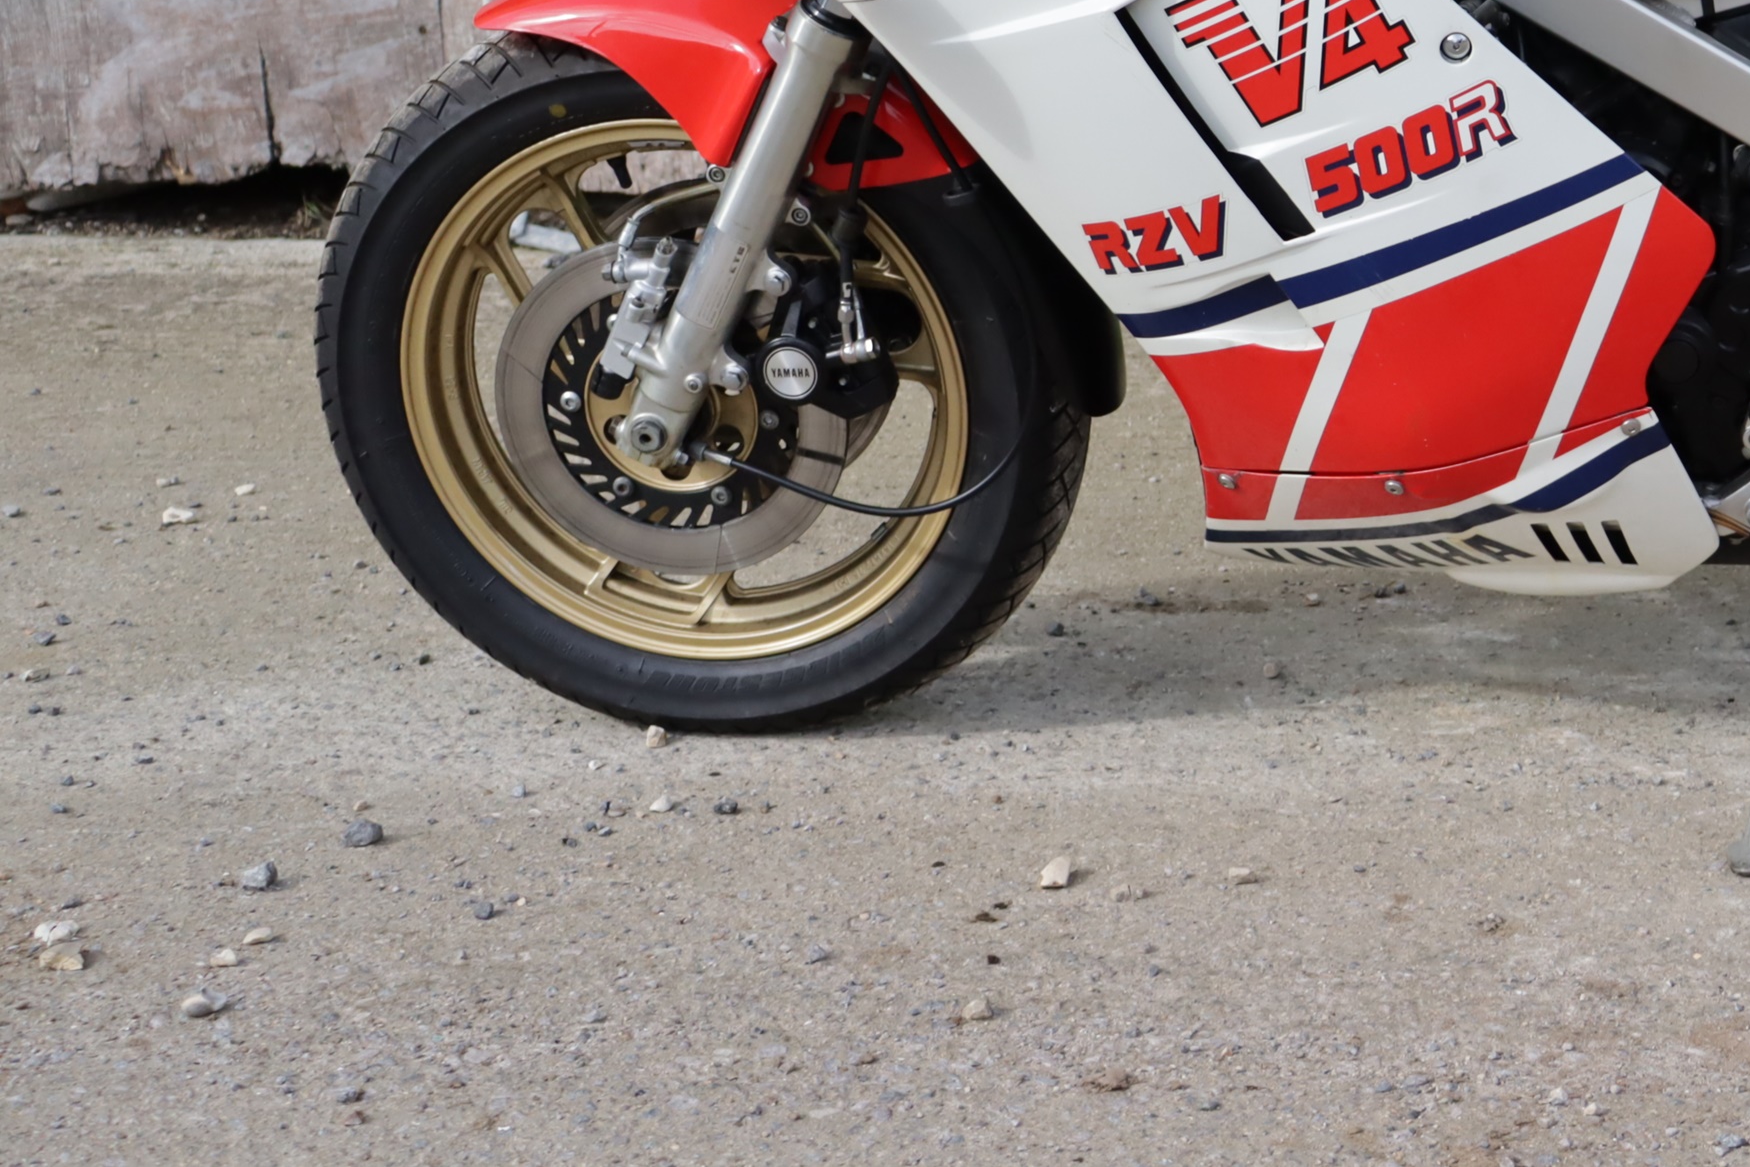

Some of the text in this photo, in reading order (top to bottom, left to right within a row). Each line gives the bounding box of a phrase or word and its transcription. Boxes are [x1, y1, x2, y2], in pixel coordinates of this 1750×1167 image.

[1305, 79, 1518, 217] 500R
[1081, 195, 1227, 274] RZV
[771, 368, 811, 378] YAMAHA
[1242, 533, 1536, 568] YAMAHA
